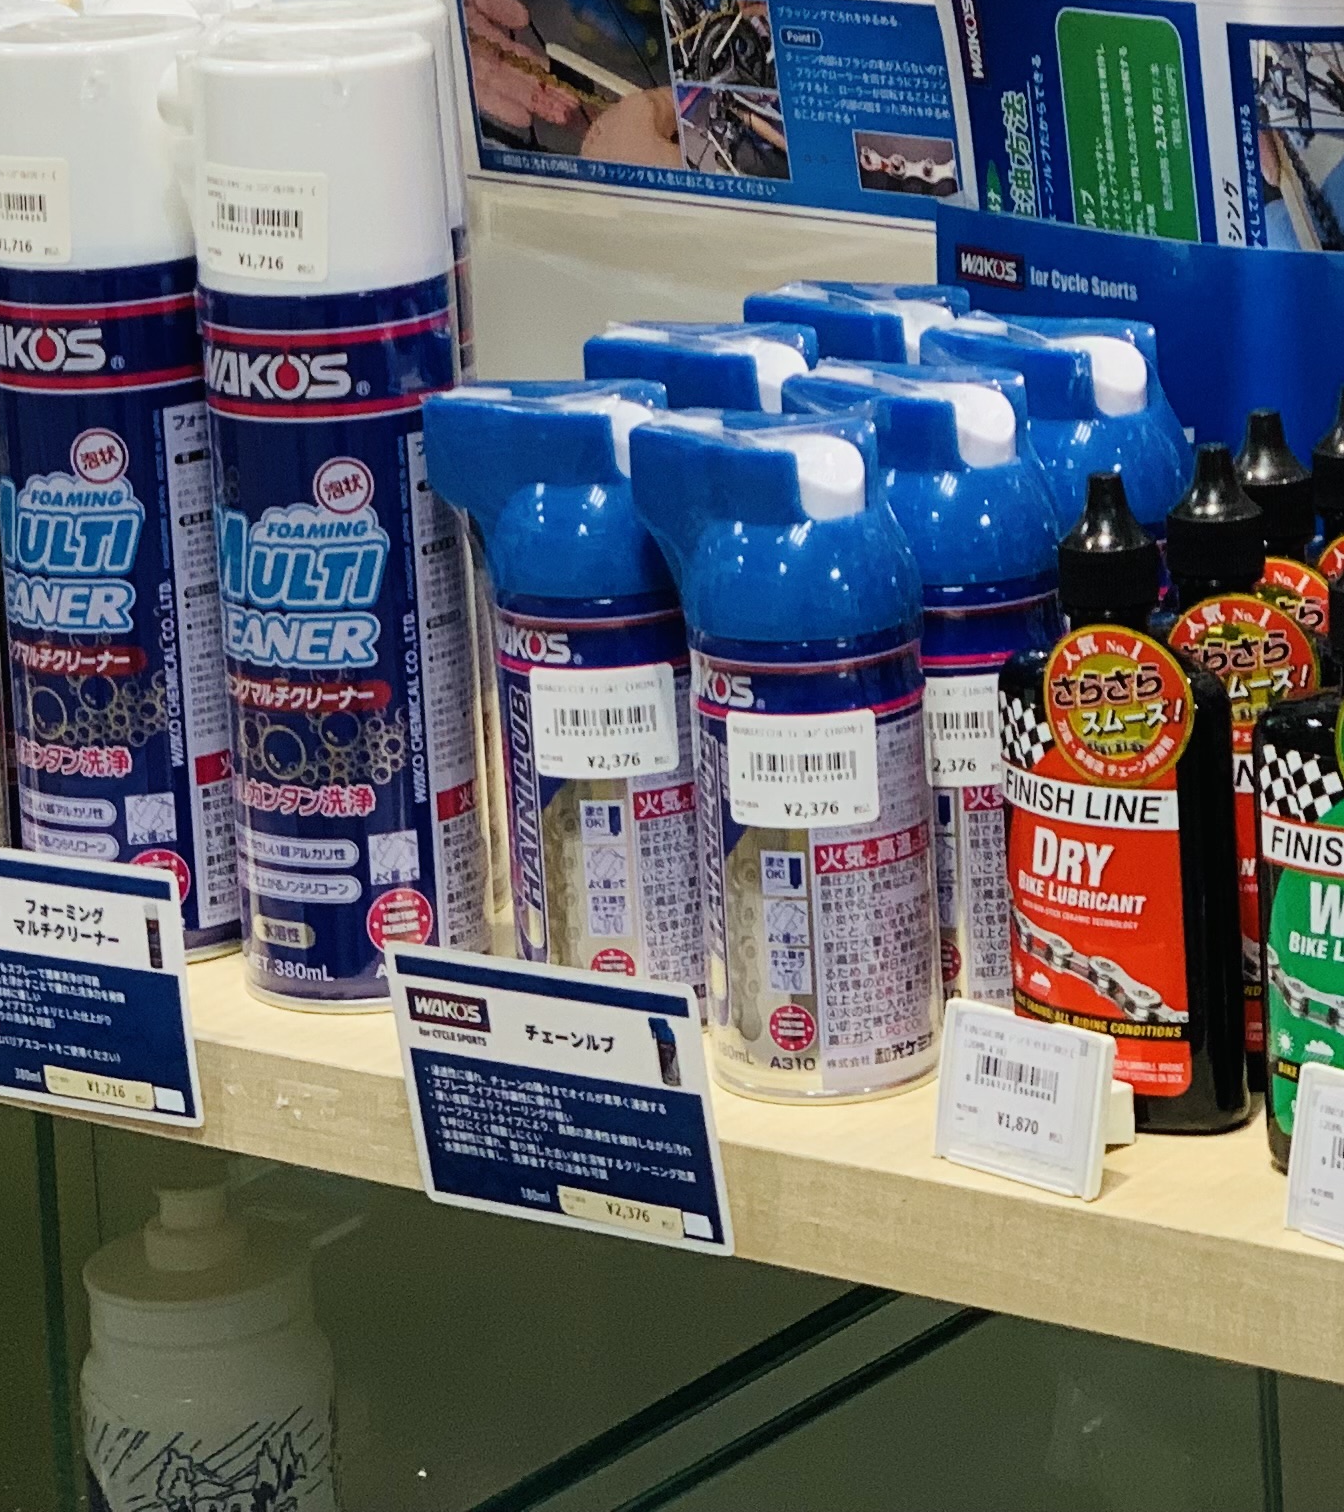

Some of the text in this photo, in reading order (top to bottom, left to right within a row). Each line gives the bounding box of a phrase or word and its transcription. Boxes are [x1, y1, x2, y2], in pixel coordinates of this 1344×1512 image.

[238, 253, 284, 272] ¥1,716
[1050, 271, 1138, 303] Cycle Sports
[82, 447, 120, 471] 泡状
[29, 489, 124, 509] FOAMING
[324, 476, 364, 502] 泡状
[266, 521, 368, 539] FOAMING
[1063, 634, 1143, 671] 人気 No.1
[1051, 663, 1165, 709] さらさら
[587, 752, 641, 769] ¥2,376
[784, 801, 840, 817] ¥2,376
[1006, 771, 1162, 824] FINISH LINE
[1032, 825, 1115, 887] DRY
[1018, 869, 1147, 915] BIKE LUBRICANT
[25, 899, 105, 923] フォーミング
[13, 919, 120, 947] マルチクリーナー
[1288, 931, 1327, 959] BIKE
[525, 1024, 615, 1053] チェーンルブ
[1110, 1018, 1182, 1038] CONDITIONS
[769, 1055, 816, 1072] A310
[997, 1113, 1039, 1137] ¥1,870
[606, 1201, 651, 1223] ¥2,376
